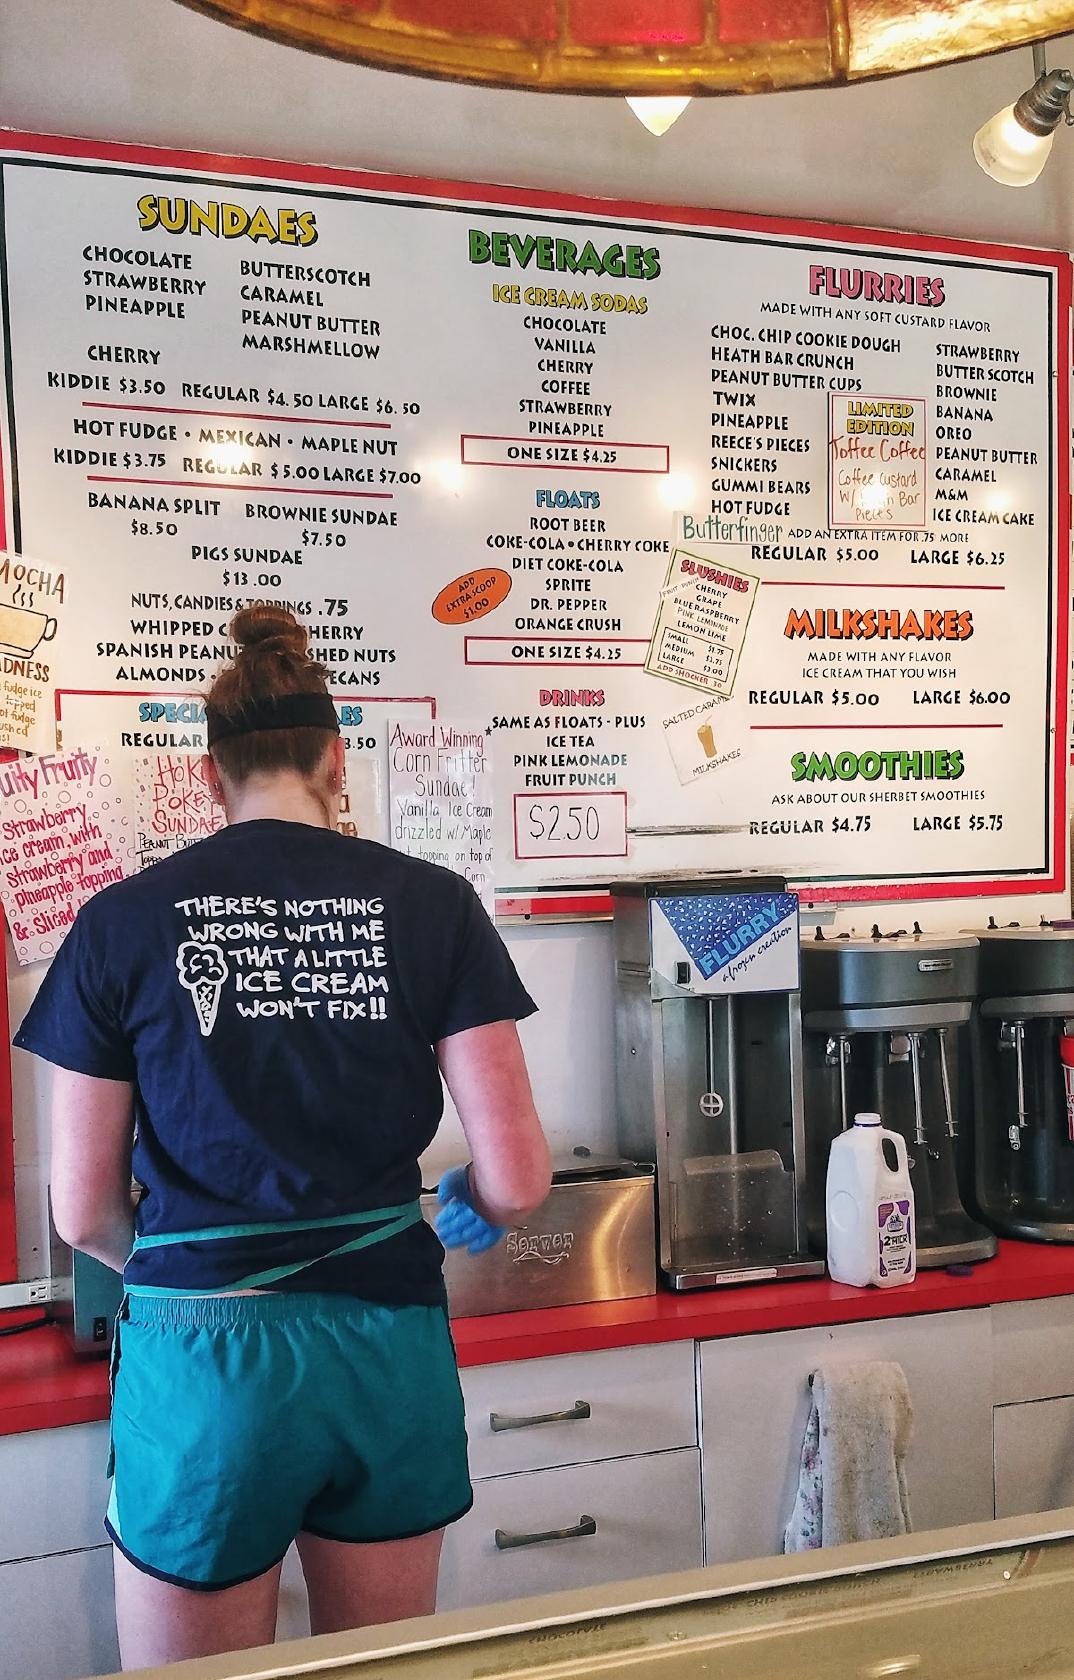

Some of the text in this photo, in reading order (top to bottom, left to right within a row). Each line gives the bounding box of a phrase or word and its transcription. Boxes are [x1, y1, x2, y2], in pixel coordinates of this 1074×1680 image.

[137, 195, 319, 246] SUNDAES
[82, 245, 192, 270] CHOCOLATE
[468, 229, 661, 280] BEVERAGES
[83, 270, 206, 296] STRAWBERRY
[240, 260, 371, 287] BUTTERSCOTCH
[240, 285, 324, 307] CARAMEL
[809, 265, 946, 308] FLURRIES
[85, 295, 186, 319] PINEAPPLE
[492, 284, 648, 315] ICE CREAM SODAS
[242, 309, 381, 337] PEANUT BUTTER
[523, 316, 607, 335] CHOCOLATE
[760, 301, 991, 333] MADE WITH ANY SOFT CUSTARD FLAVOR
[242, 334, 380, 360] MARSHMELLOW
[534, 337, 596, 354] VANILLA
[711, 325, 901, 353] CHOC. CHIP COOKIE DOUGH
[87, 345, 161, 365] CHERRY
[711, 347, 855, 370] HEATH BAR CRUNCH
[935, 343, 1020, 364] STRAWBERRY
[537, 359, 594, 375] CHERRY
[47, 372, 166, 396] KIDDIE $3.50
[541, 380, 591, 396] COFFEE
[711, 369, 862, 392] PEANUT BUTTER CUPS
[182, 383, 260, 403] REGULAR
[318, 393, 369, 412] LARGE
[713, 391, 756, 407] TWIX
[936, 385, 998, 402] BROWNIE
[519, 399, 612, 417] STRAWBERRY
[847, 401, 914, 419] LIMITED
[936, 406, 994, 423] BANANA
[528, 421, 604, 438] PINEAPPLE
[711, 413, 789, 431] PINEAPPLE
[847, 419, 914, 437] EDITION
[73, 418, 398, 456] HOT FUDGE MEXICAN MAPLE NUT
[936, 426, 973, 441] OREO
[711, 434, 811, 453] REECE'S PIECES
[829, 435, 926, 462] Toffee Coffee
[54, 448, 166, 468] KIDDIE $3.75
[507, 446, 617, 464] ONE SIZE $4.25
[711, 456, 778, 473] SNICKERS
[936, 447, 1039, 465] PEANUT BUTTER
[270, 463, 421, 485] $5.00 LARGE $7.00
[935, 468, 997, 483] CARAMEL
[711, 479, 811, 496] GUMMI BEARS
[87, 492, 221, 516] BANANA SPLIT
[536, 490, 601, 509] FLOATS
[245, 503, 398, 527] BROWNIE SUNDAE
[933, 509, 1035, 526] ICE CREAM CAKE
[530, 517, 606, 533] ROOT BEER
[683, 516, 784, 545] Butterfinger
[191, 546, 303, 565] PIGS SUNDAE
[751, 545, 880, 563] REGULAR $5.00
[911, 550, 1006, 567] LARGE $6.25
[458, 577, 475, 593] ADD
[545, 578, 591, 592] SPRITE
[680, 559, 750, 594] SLUSHIES
[695, 583, 728, 599] CHERRY
[463, 598, 490, 619] $1.00
[530, 598, 608, 611] DR. PEPPER
[696, 594, 722, 609] GRAPE
[515, 617, 621, 631] ORANGE CRUSH
[784, 607, 974, 641] MILKSHAKES
[97, 643, 174, 660] SPANISH
[807, 651, 952, 663] MADE WITH ANY FLAVOR
[116, 667, 206, 683] ALMONDS
[539, 689, 605, 707] DRINKS
[748, 689, 880, 707] REGULAR $5.00
[913, 689, 1011, 705] LARGE $6.00
[492, 716, 646, 729] SAME AS FLOATS PLUS
[121, 733, 203, 748] REGULAR
[390, 724, 484, 758] Award Winning
[546, 736, 595, 748] ICE TEA
[513, 754, 628, 767] PINK LEMONADE
[790, 750, 965, 782] SMOOTHIES
[525, 773, 616, 786] FRUIT PUNCH
[771, 789, 985, 805] ASK ABOUT OUR SHERBET SMOOTHIES
[528, 804, 600, 841] $2.50
[831, 815, 871, 833] $4.75
[913, 814, 1003, 831] LARGE $5.75
[175, 895, 385, 919] THERE'S NOTHING
[188, 919, 386, 943] WRONG WITH ME
[699, 900, 780, 976] FLURRY
[228, 945, 388, 968] THAT A LITTLE
[235, 970, 390, 995] ICE CREAM
[236, 996, 388, 1020] WON'T FIX!!
